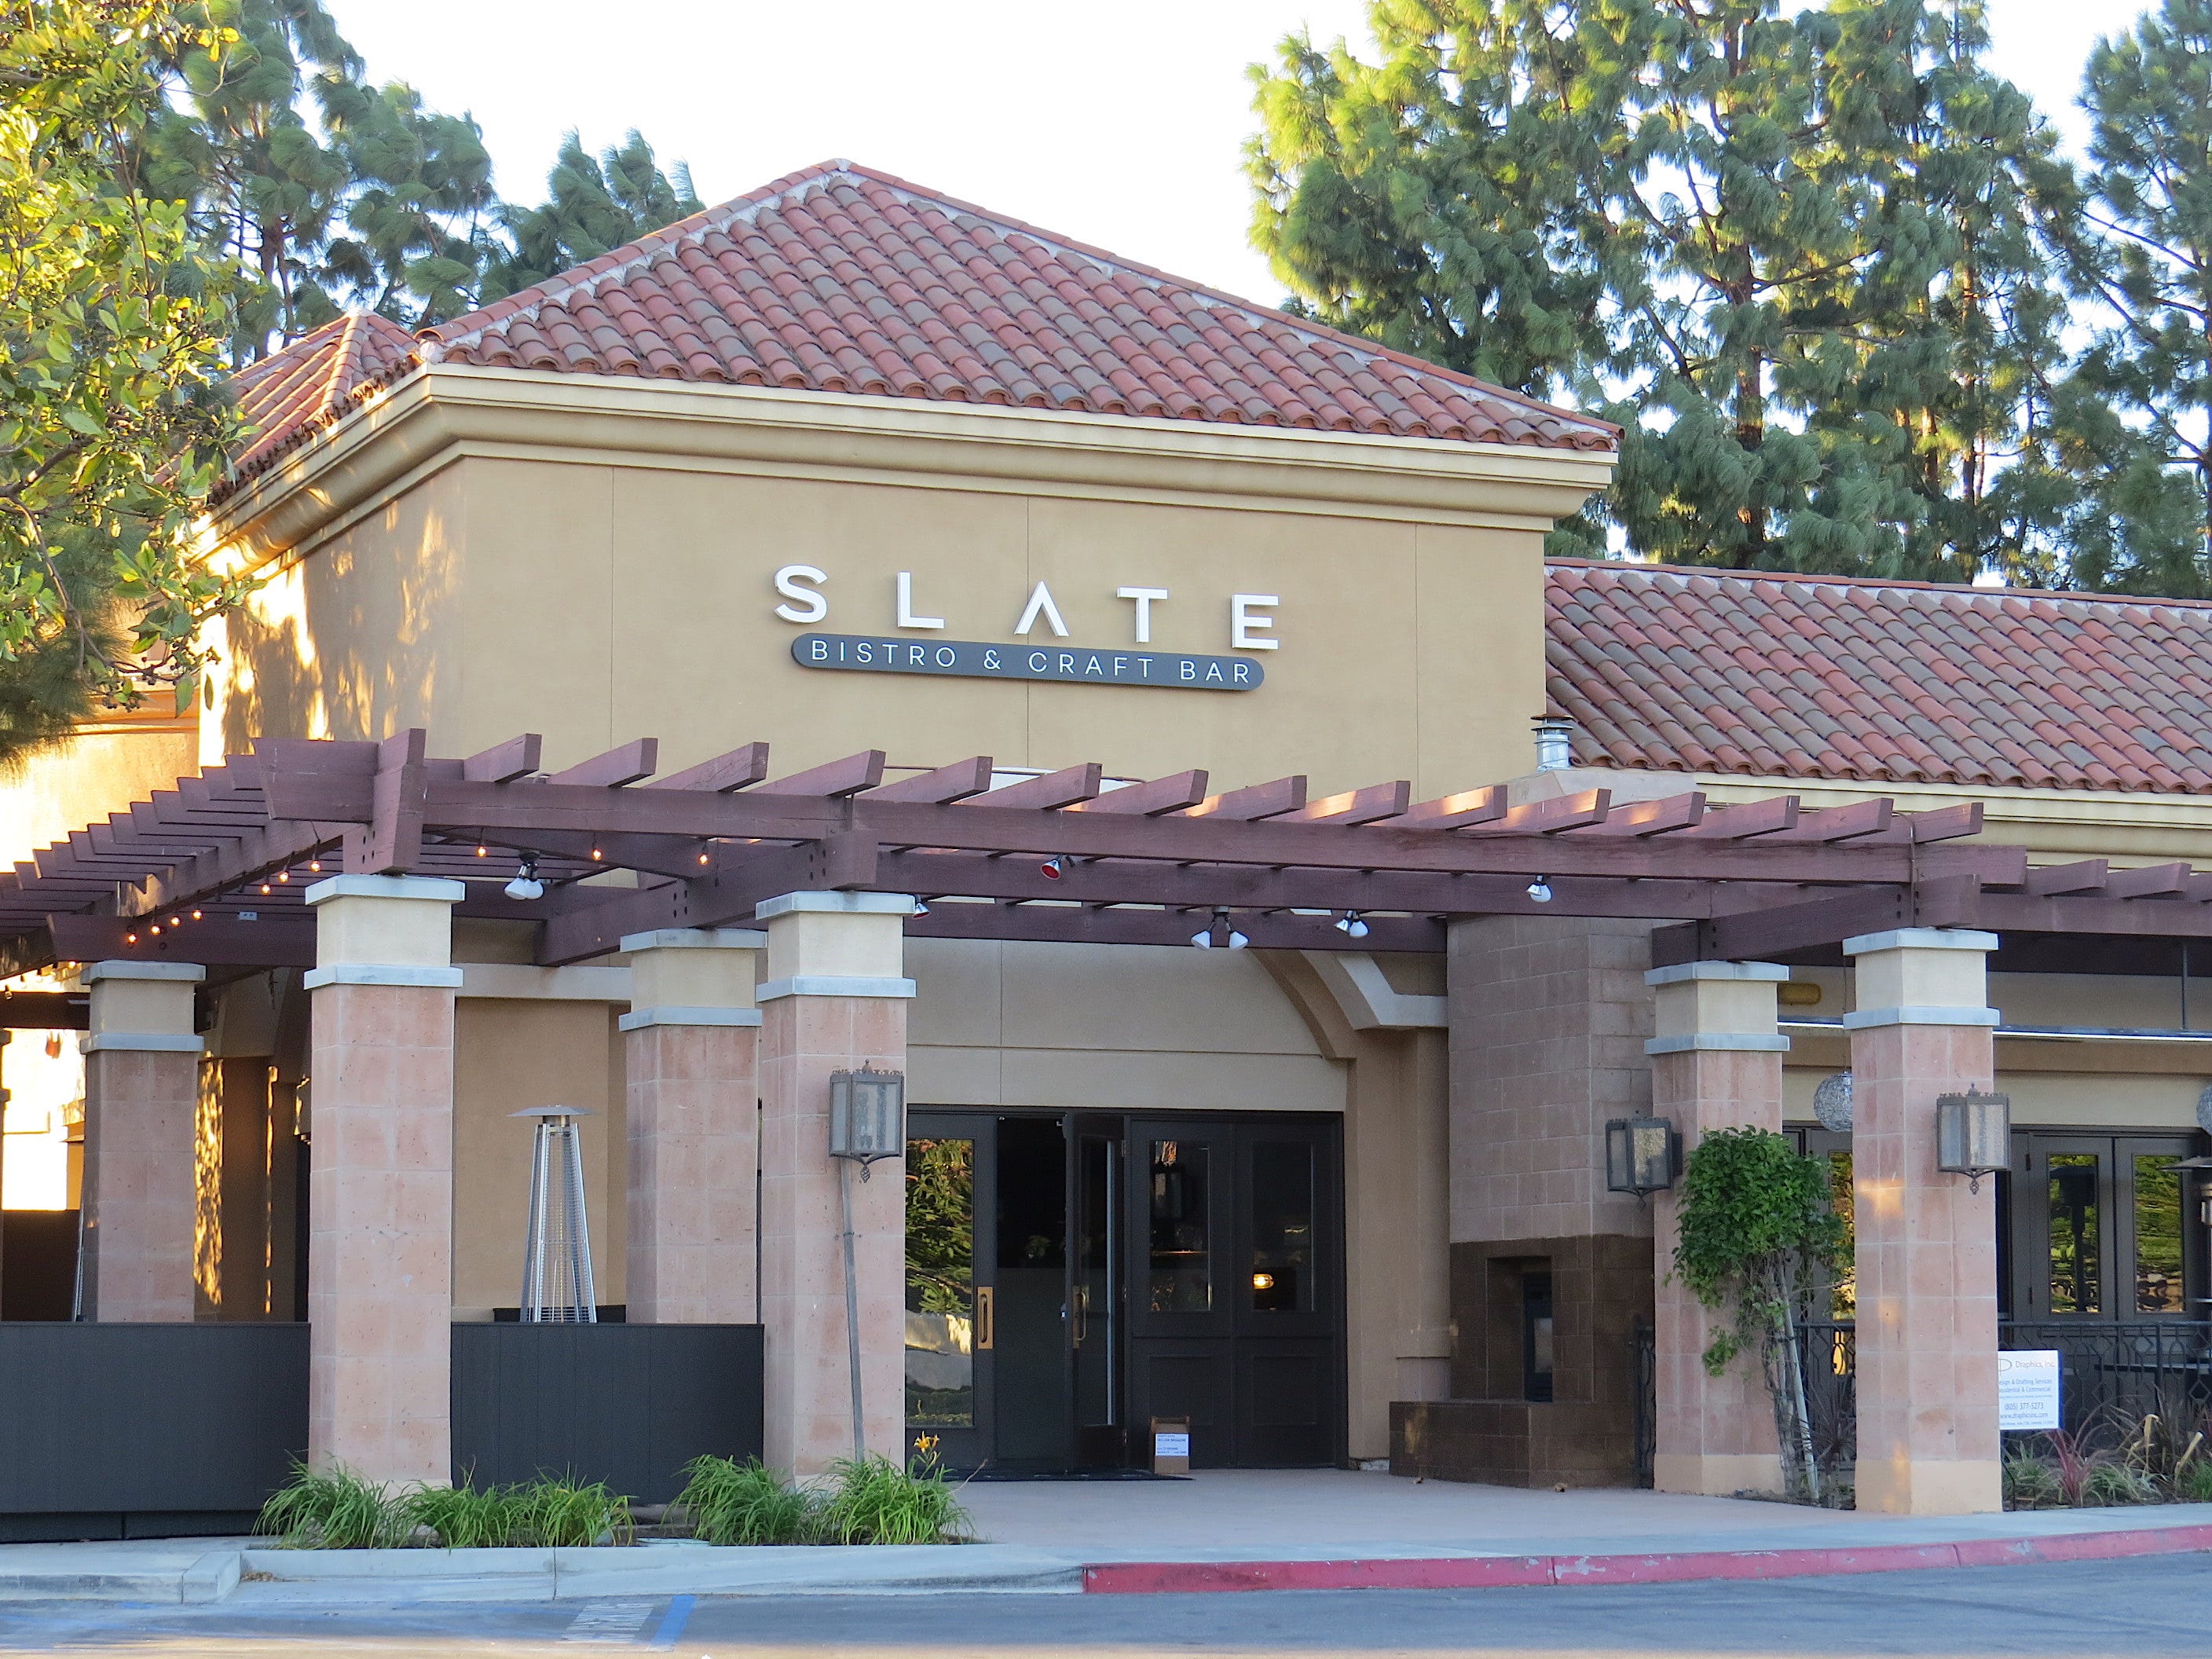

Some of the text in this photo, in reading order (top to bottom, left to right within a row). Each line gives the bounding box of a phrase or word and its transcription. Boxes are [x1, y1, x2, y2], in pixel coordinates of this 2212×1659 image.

[774, 564, 1280, 650] SLATE
[811, 639, 1250, 684] BISTRO & CRAFT BAR
